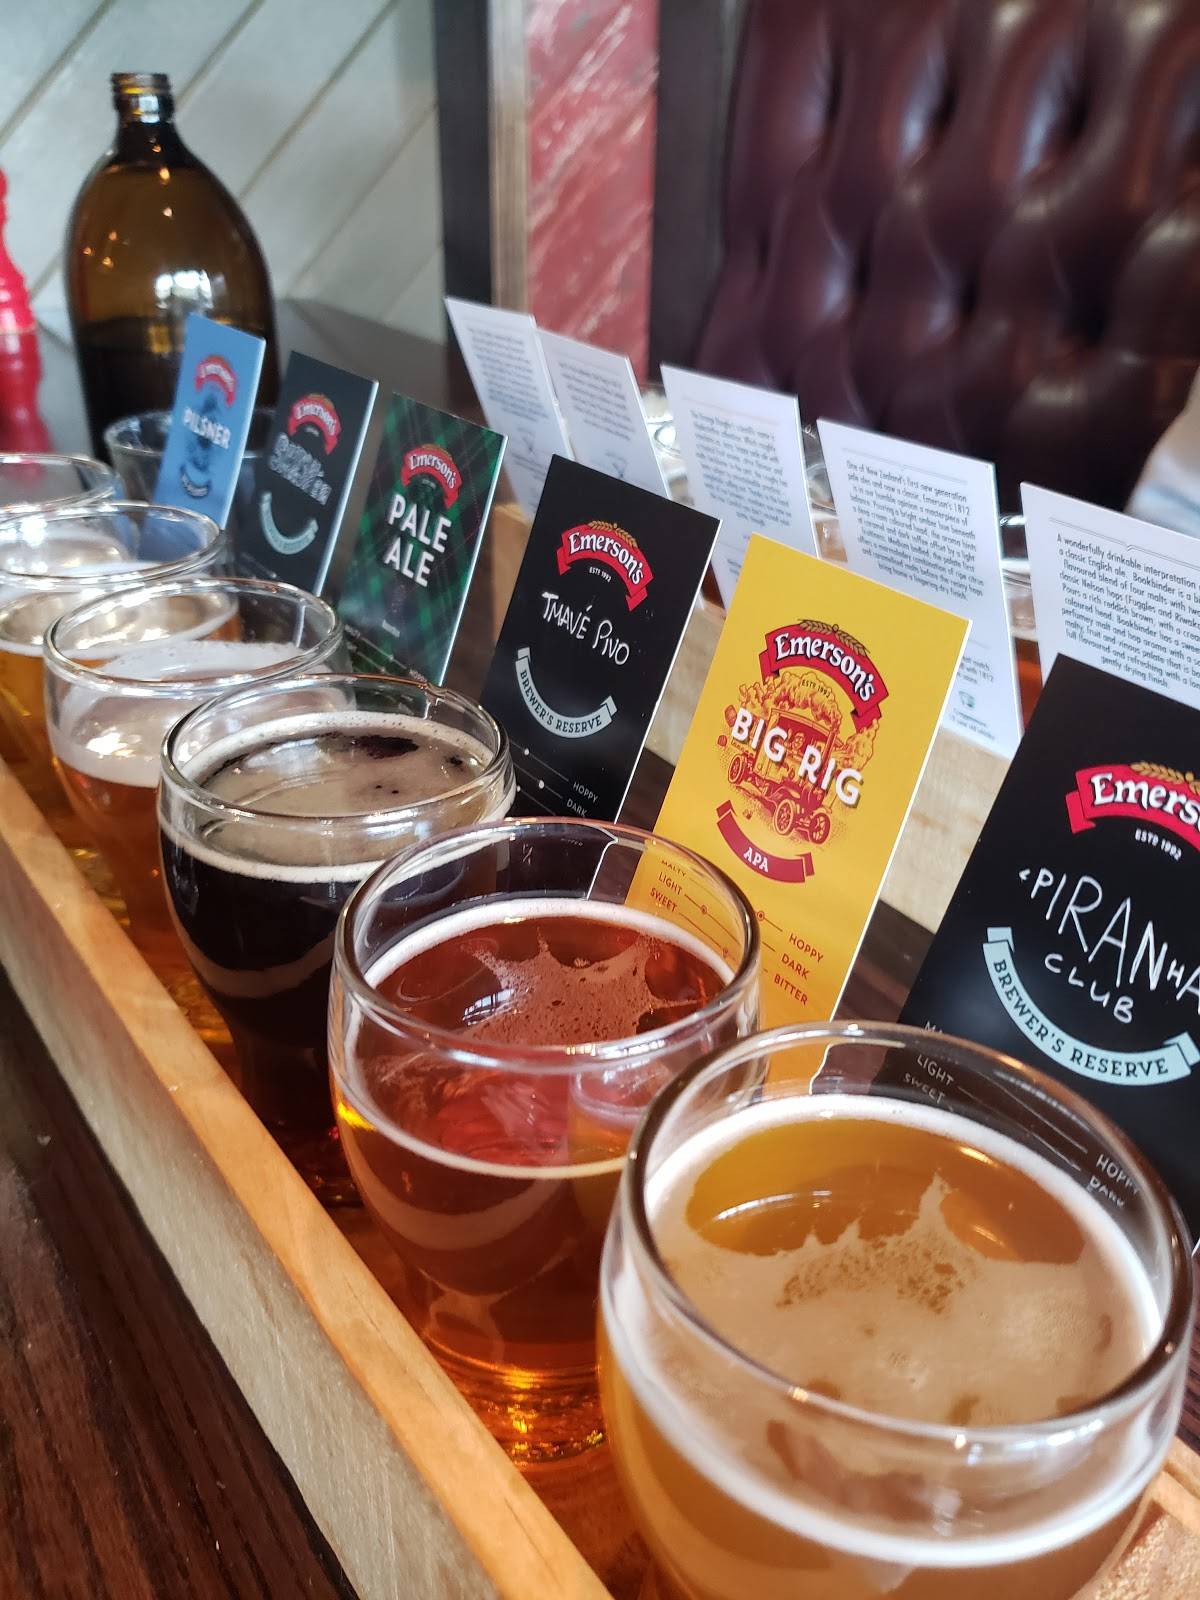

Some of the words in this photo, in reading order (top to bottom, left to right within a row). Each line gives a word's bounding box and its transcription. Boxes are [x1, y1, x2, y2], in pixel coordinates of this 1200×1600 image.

[183, 406, 231, 449] PILSNER
[409, 454, 456, 489] Emerson's
[935, 488, 966, 502] generation
[388, 494, 452, 553] PALE
[384, 537, 434, 587] ALE
[568, 531, 644, 585] Emerson's
[1057, 534, 1061, 542] A
[1064, 539, 1104, 559] wonderfully
[1106, 550, 1141, 569] drinkable
[1143, 563, 1195, 588] interpretation
[1065, 550, 1085, 563] classic
[1088, 557, 1111, 572] English
[1133, 572, 1174, 594] Bookbinder
[1064, 561, 1096, 579] flavoured
[1099, 573, 1117, 587] blend
[1120, 582, 1127, 590] of
[1129, 584, 1144, 596] four
[1148, 593, 1167, 604] malts
[1170, 600, 1185, 611] with
[1082, 578, 1104, 594] Nelson
[1106, 587, 1122, 601] hops
[1158, 609, 1172, 618] and
[541, 591, 592, 639] TMAVÉ
[1065, 598, 1093, 613] coloured
[1117, 615, 1156, 637] Bookbinder
[1160, 631, 1171, 643] has
[1089, 594, 1100, 604] rich
[1104, 601, 1128, 614] reddish
[1158, 620, 1173, 631] with
[1087, 626, 1100, 638] fruit
[1103, 635, 1115, 644] and
[1167, 657, 1181, 670] that
[1096, 621, 1110, 631] malt
[1113, 627, 1125, 636] and
[1127, 630, 1141, 645] hop
[1143, 639, 1166, 652] aroma
[1171, 649, 1184, 659] with
[774, 632, 855, 702] Emerson's
[1113, 650, 1125, 659] and
[1128, 656, 1163, 676] refreshing
[1166, 670, 1180, 681] with
[520, 669, 554, 726] BREWER'S
[555, 715, 602, 733] RESERVE
[731, 707, 788, 763] BIG
[798, 744, 863, 807] RIG
[566, 798, 588, 817] DARK
[573, 782, 599, 803] HOPPY
[1090, 771, 1200, 832] Emers
[743, 847, 769, 872] APA
[1160, 838, 1182, 861] 1992
[650, 888, 677, 913] SWEET
[658, 872, 683, 895] LIGHT
[781, 953, 810, 980] DARK
[788, 932, 824, 963] HOPPY
[774, 974, 808, 1006] BITTER
[1044, 953, 1134, 1024] CLUB
[993, 959, 1065, 1053] BREWER'S
[1070, 1046, 1169, 1078] RESERVE
[904, 1072, 945, 1104] SWEET
[917, 1054, 954, 1086] LIGHT
